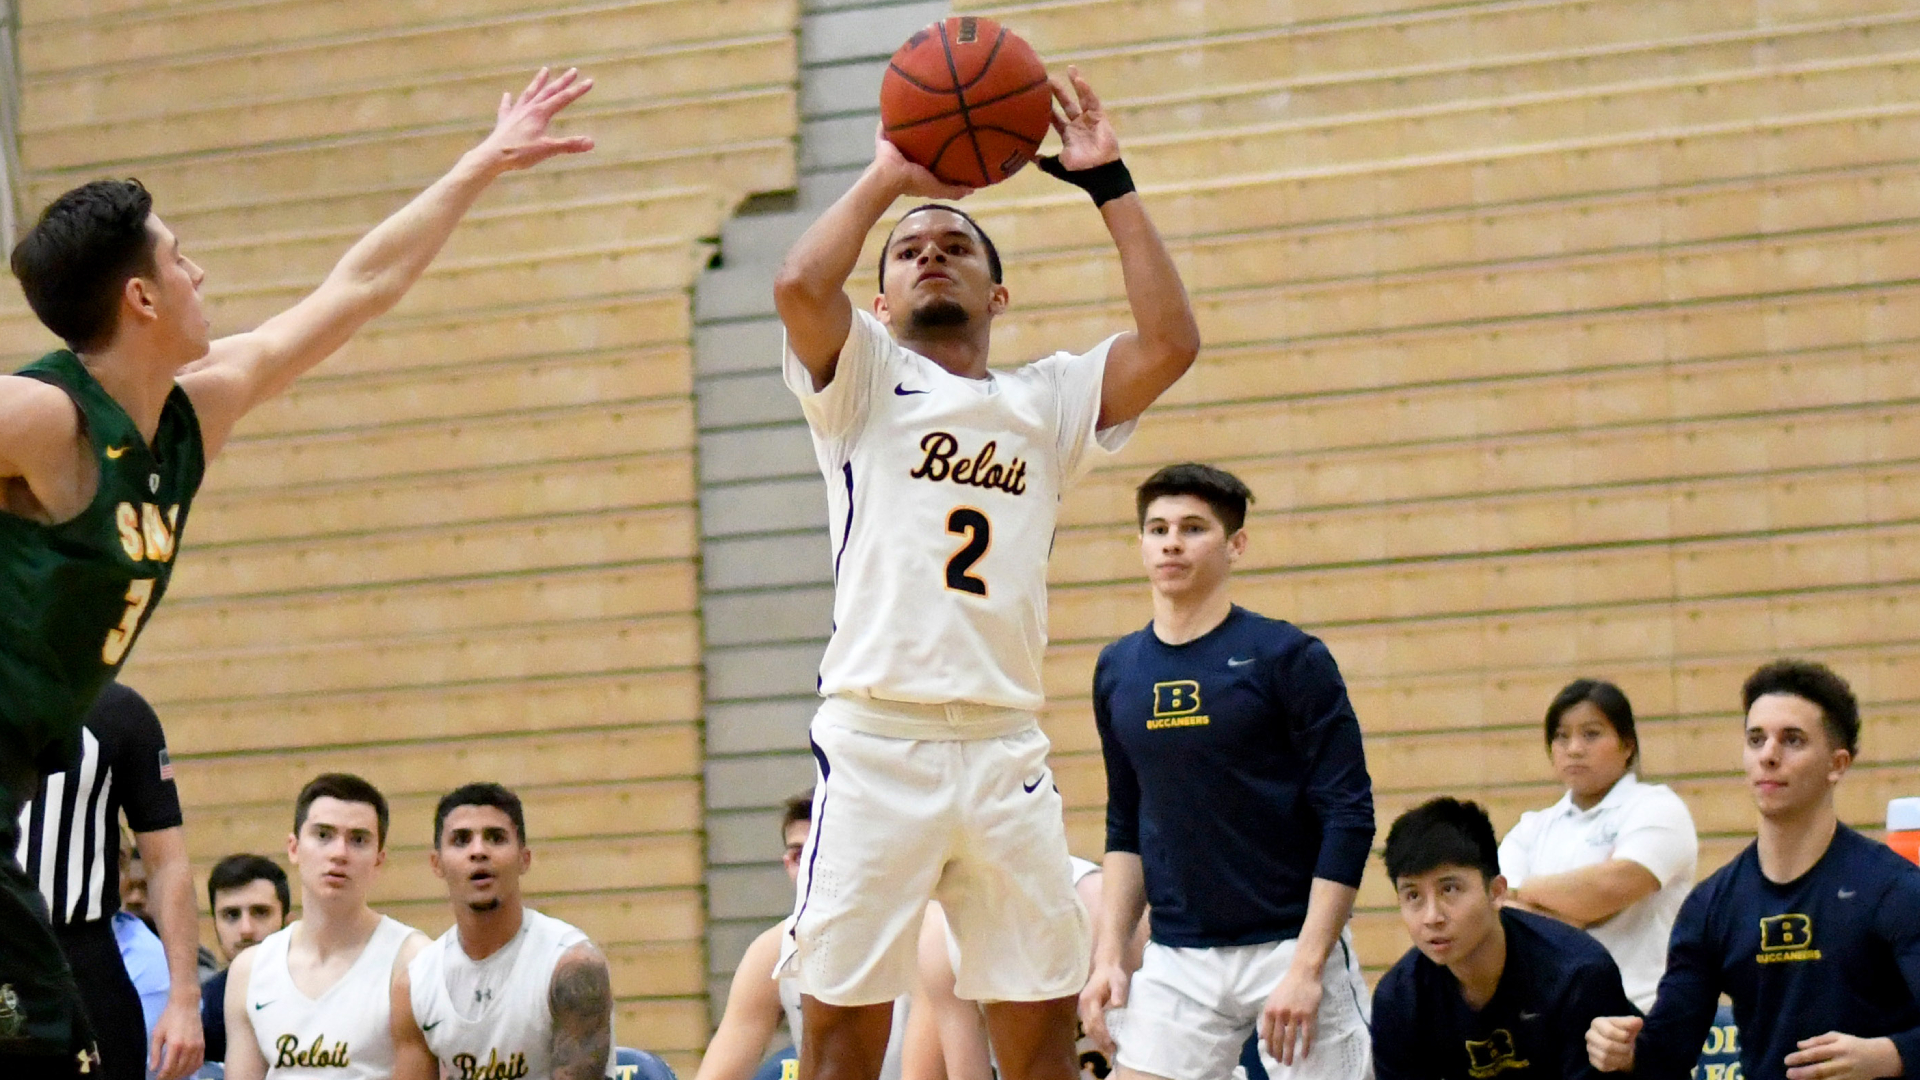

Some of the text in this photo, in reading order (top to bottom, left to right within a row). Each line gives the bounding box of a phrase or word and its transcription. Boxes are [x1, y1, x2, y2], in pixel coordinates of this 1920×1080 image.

[910, 431, 1027, 496] Beloit
[944, 504, 992, 599] 2
[1153, 680, 1200, 717] B
[1146, 715, 1210, 730] BUCCANEERS
[274, 1032, 350, 1069] Beloit
